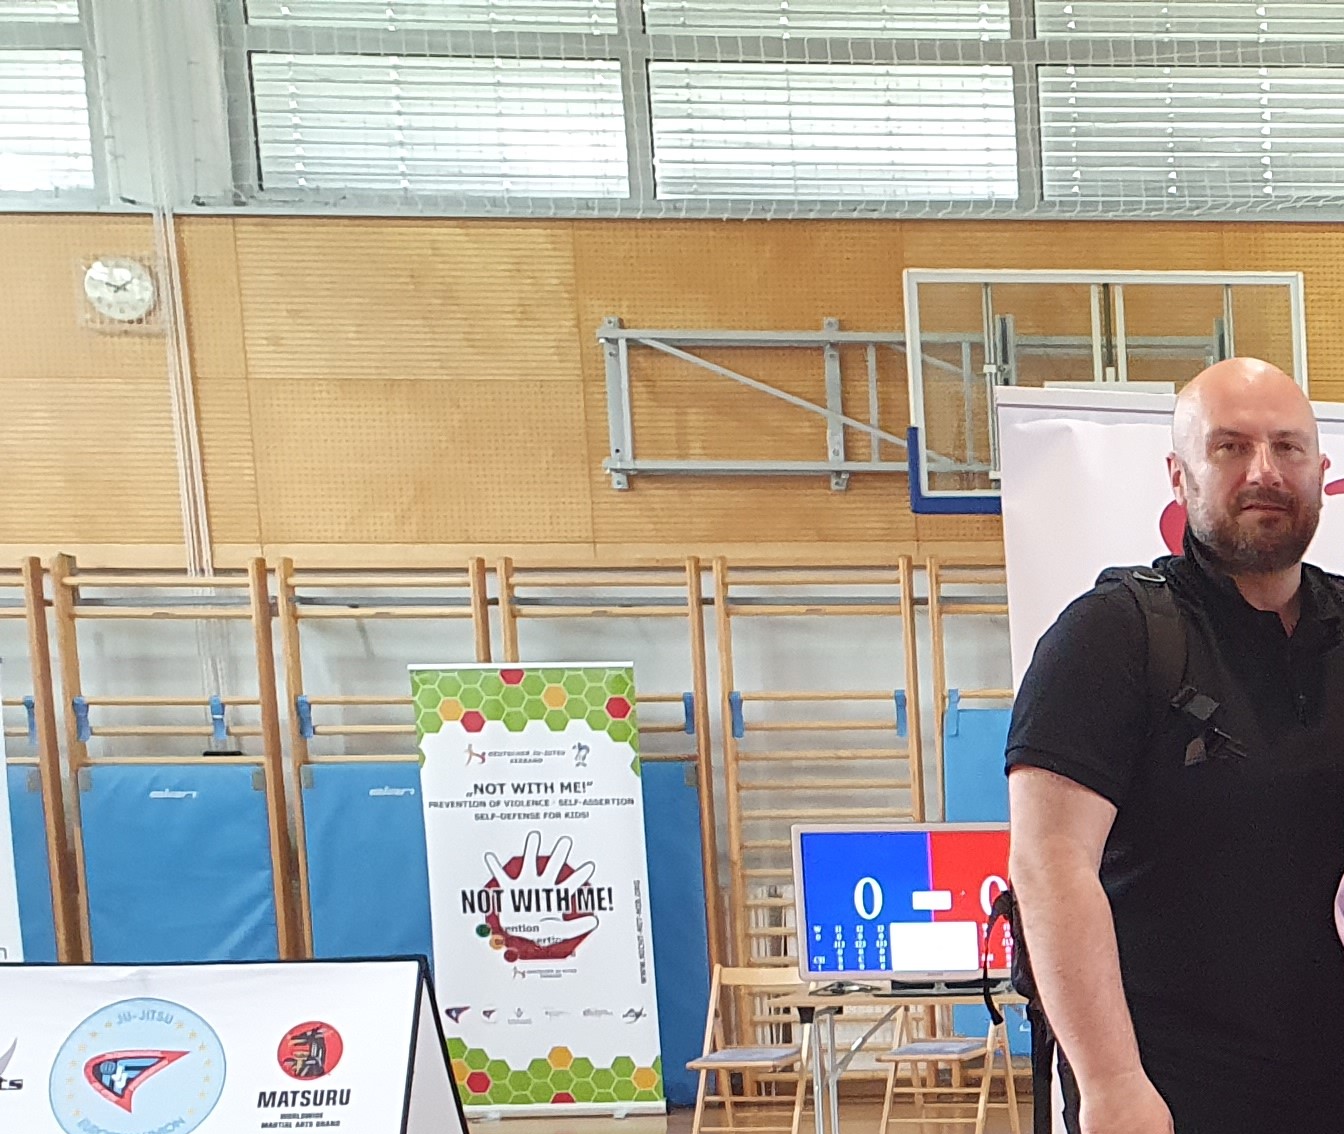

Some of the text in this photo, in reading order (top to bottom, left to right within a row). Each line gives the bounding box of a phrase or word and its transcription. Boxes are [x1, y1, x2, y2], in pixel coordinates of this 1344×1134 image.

[511, 782, 554, 794] WITH
[489, 800, 501, 808] OF
[504, 799, 550, 807] VIOLENCE
[461, 886, 614, 914] NOT WITH ME!
[854, 877, 883, 920] 0
[257, 1088, 352, 1109] MATSURU
